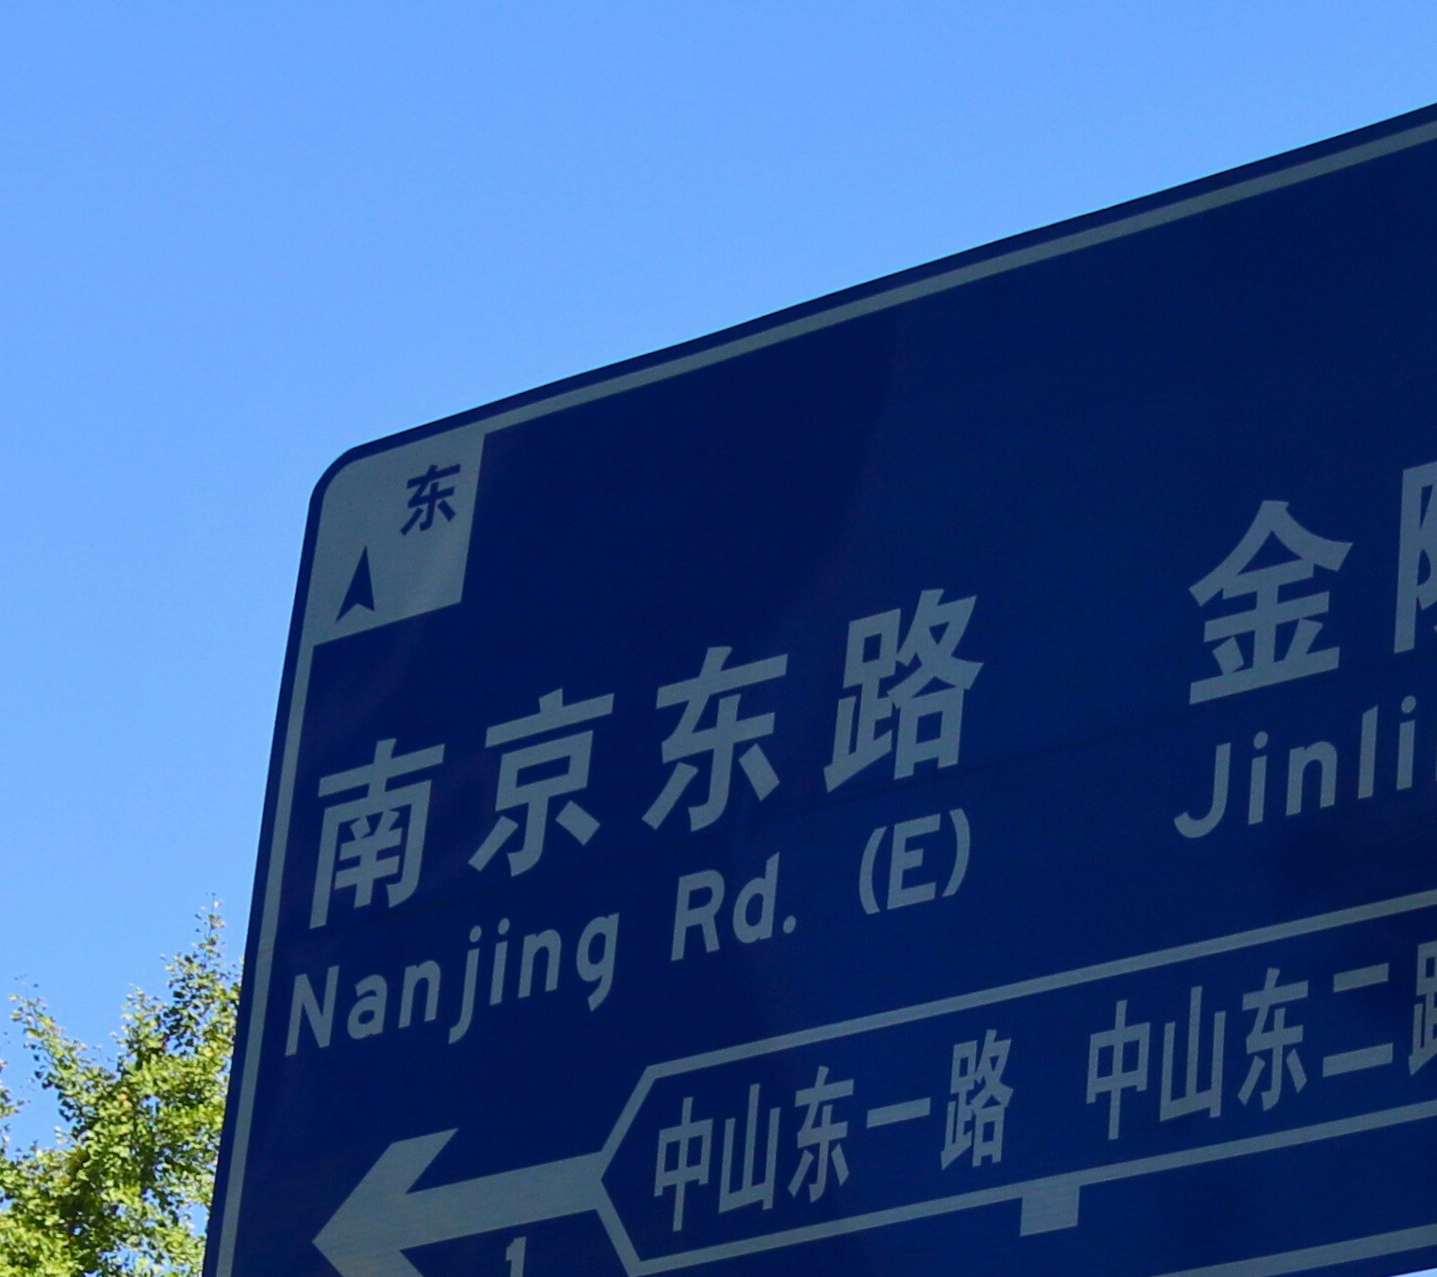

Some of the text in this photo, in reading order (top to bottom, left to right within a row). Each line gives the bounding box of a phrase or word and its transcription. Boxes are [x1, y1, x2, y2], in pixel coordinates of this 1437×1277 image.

[402, 461, 460, 536] 东
[308, 586, 983, 928] 南京东路
[286, 808, 972, 1056] Nanjing Rd. (E)
[654, 1030, 1015, 1233] 中山东一路
